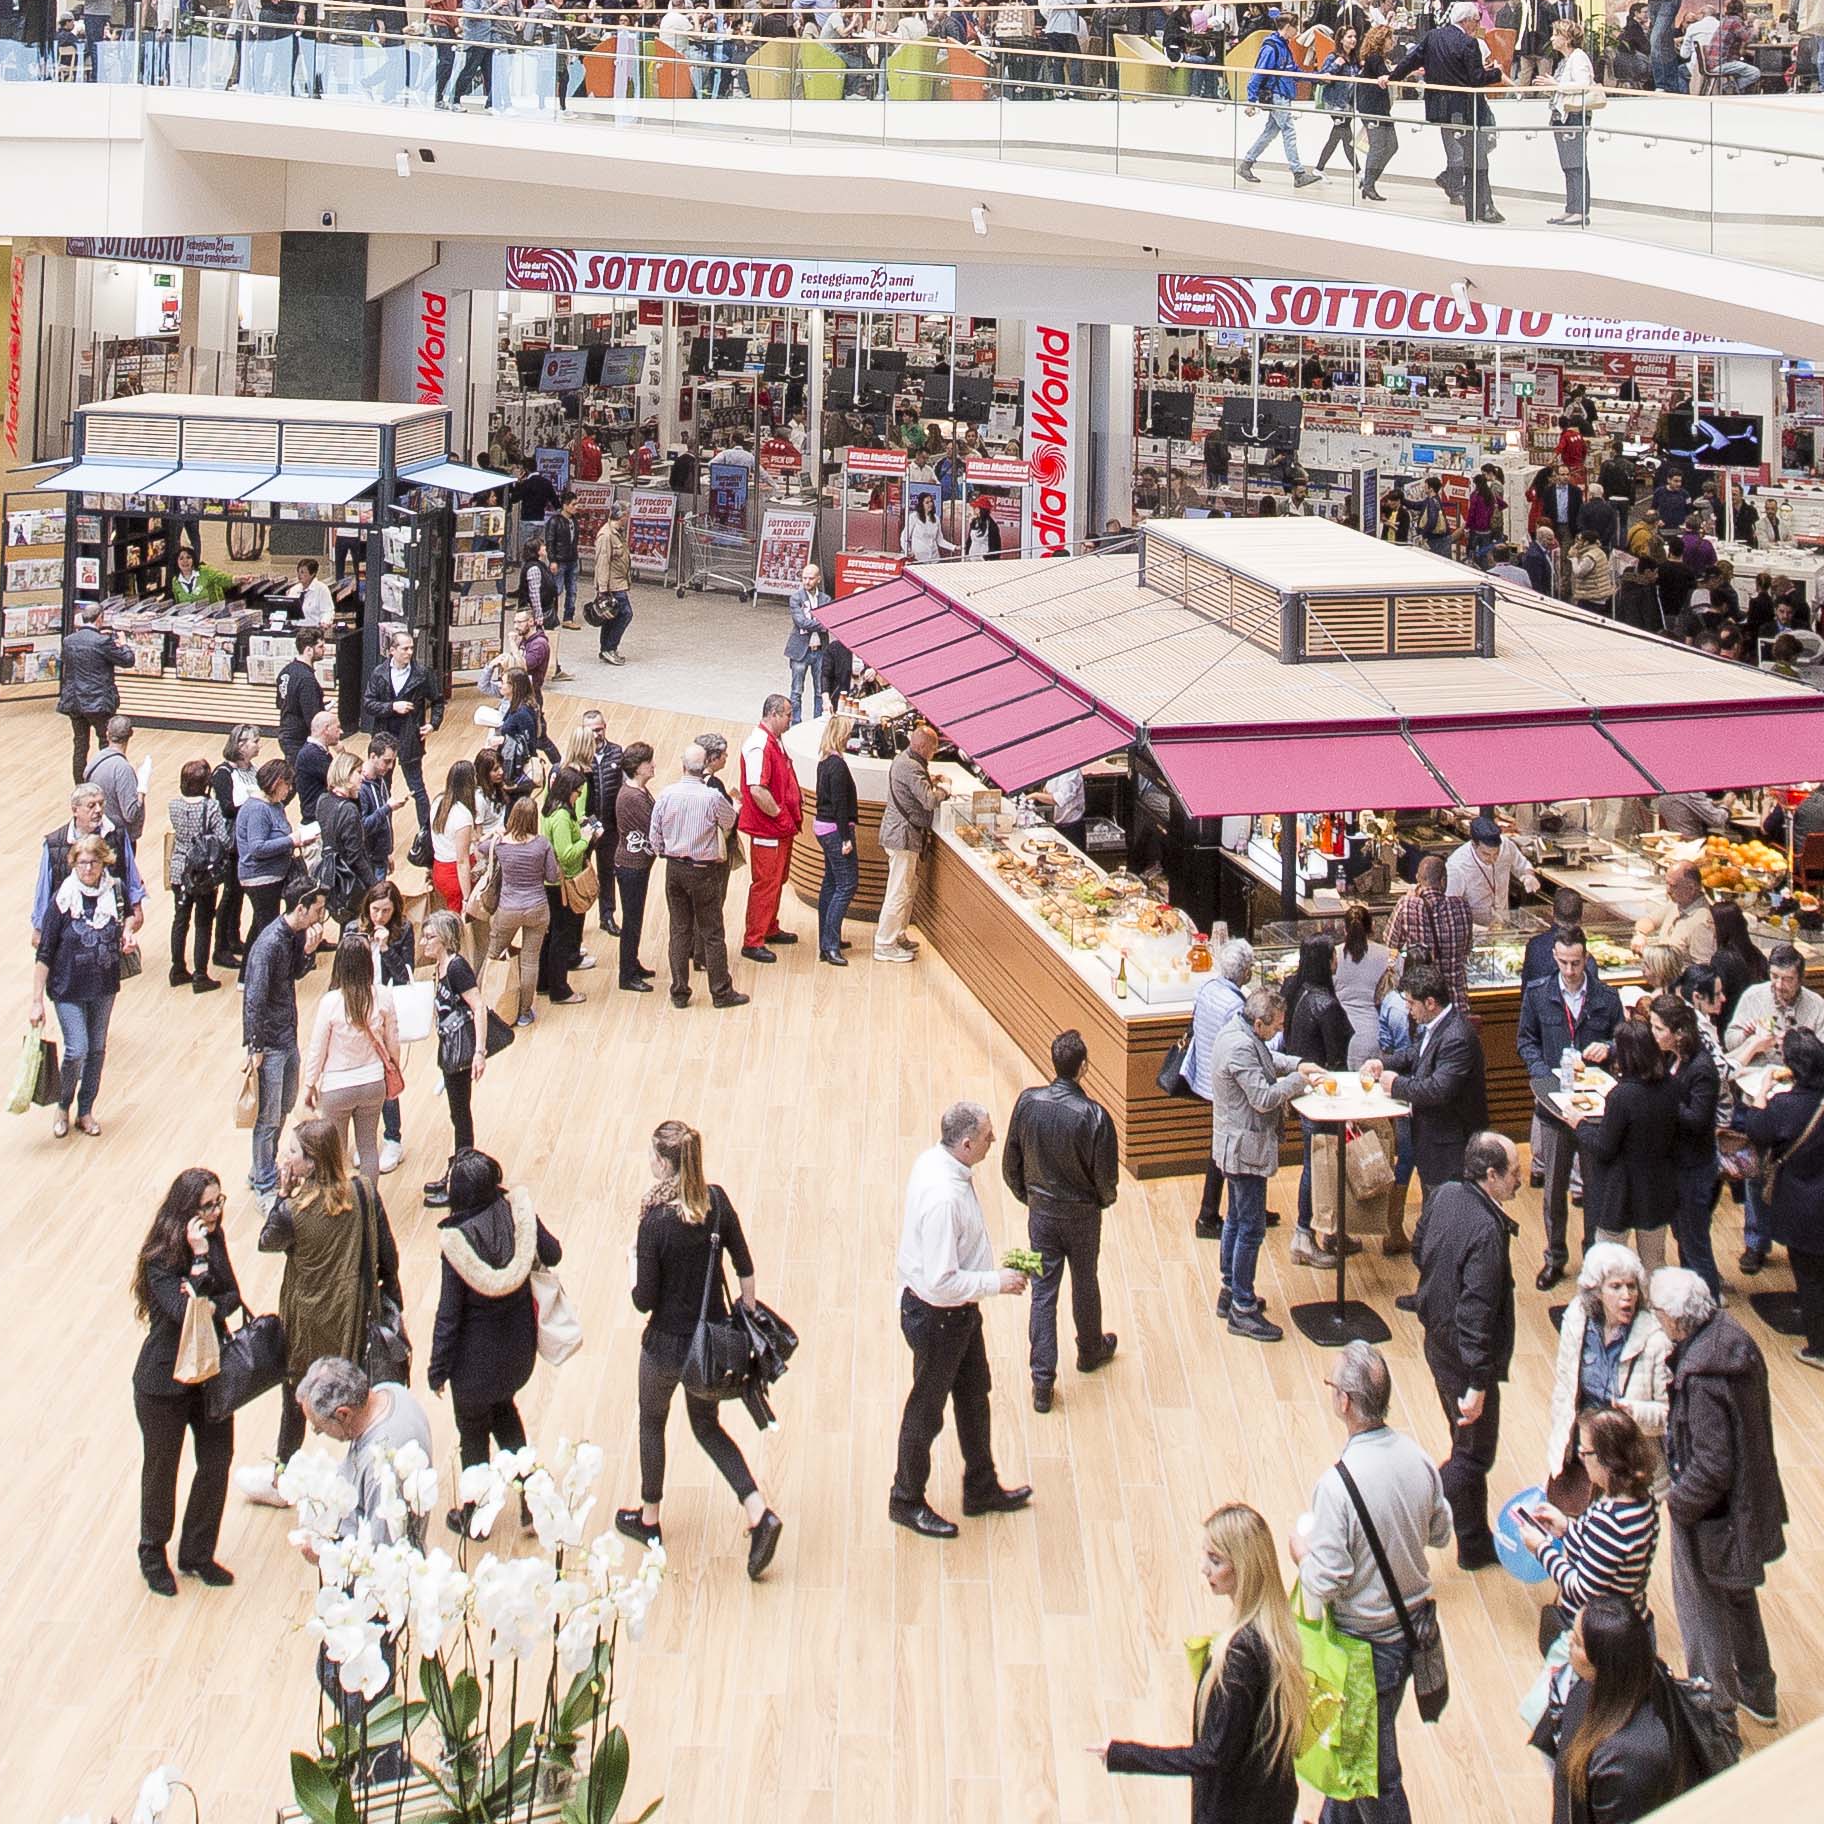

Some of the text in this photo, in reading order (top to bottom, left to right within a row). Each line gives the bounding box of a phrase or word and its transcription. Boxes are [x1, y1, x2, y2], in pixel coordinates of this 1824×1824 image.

[584, 255, 794, 299] SOTTOCOSTO
[800, 272, 869, 288] Festeggiamo
[889, 274, 914, 287] anni
[800, 289, 819, 299] con
[821, 290, 842, 300] una
[844, 289, 883, 302] grande
[1266, 284, 1553, 339] SOTTOCOSTO
[416, 291, 447, 395] World
[1565, 326, 1591, 339] con
[1595, 327, 1623, 340] una
[1625, 325, 1680, 344] grande
[1630, 353, 1672, 366] acquisti
[1634, 364, 1668, 376] online
[1031, 325, 1070, 448] World
[767, 519, 811, 529] SOTTOCOSTO
